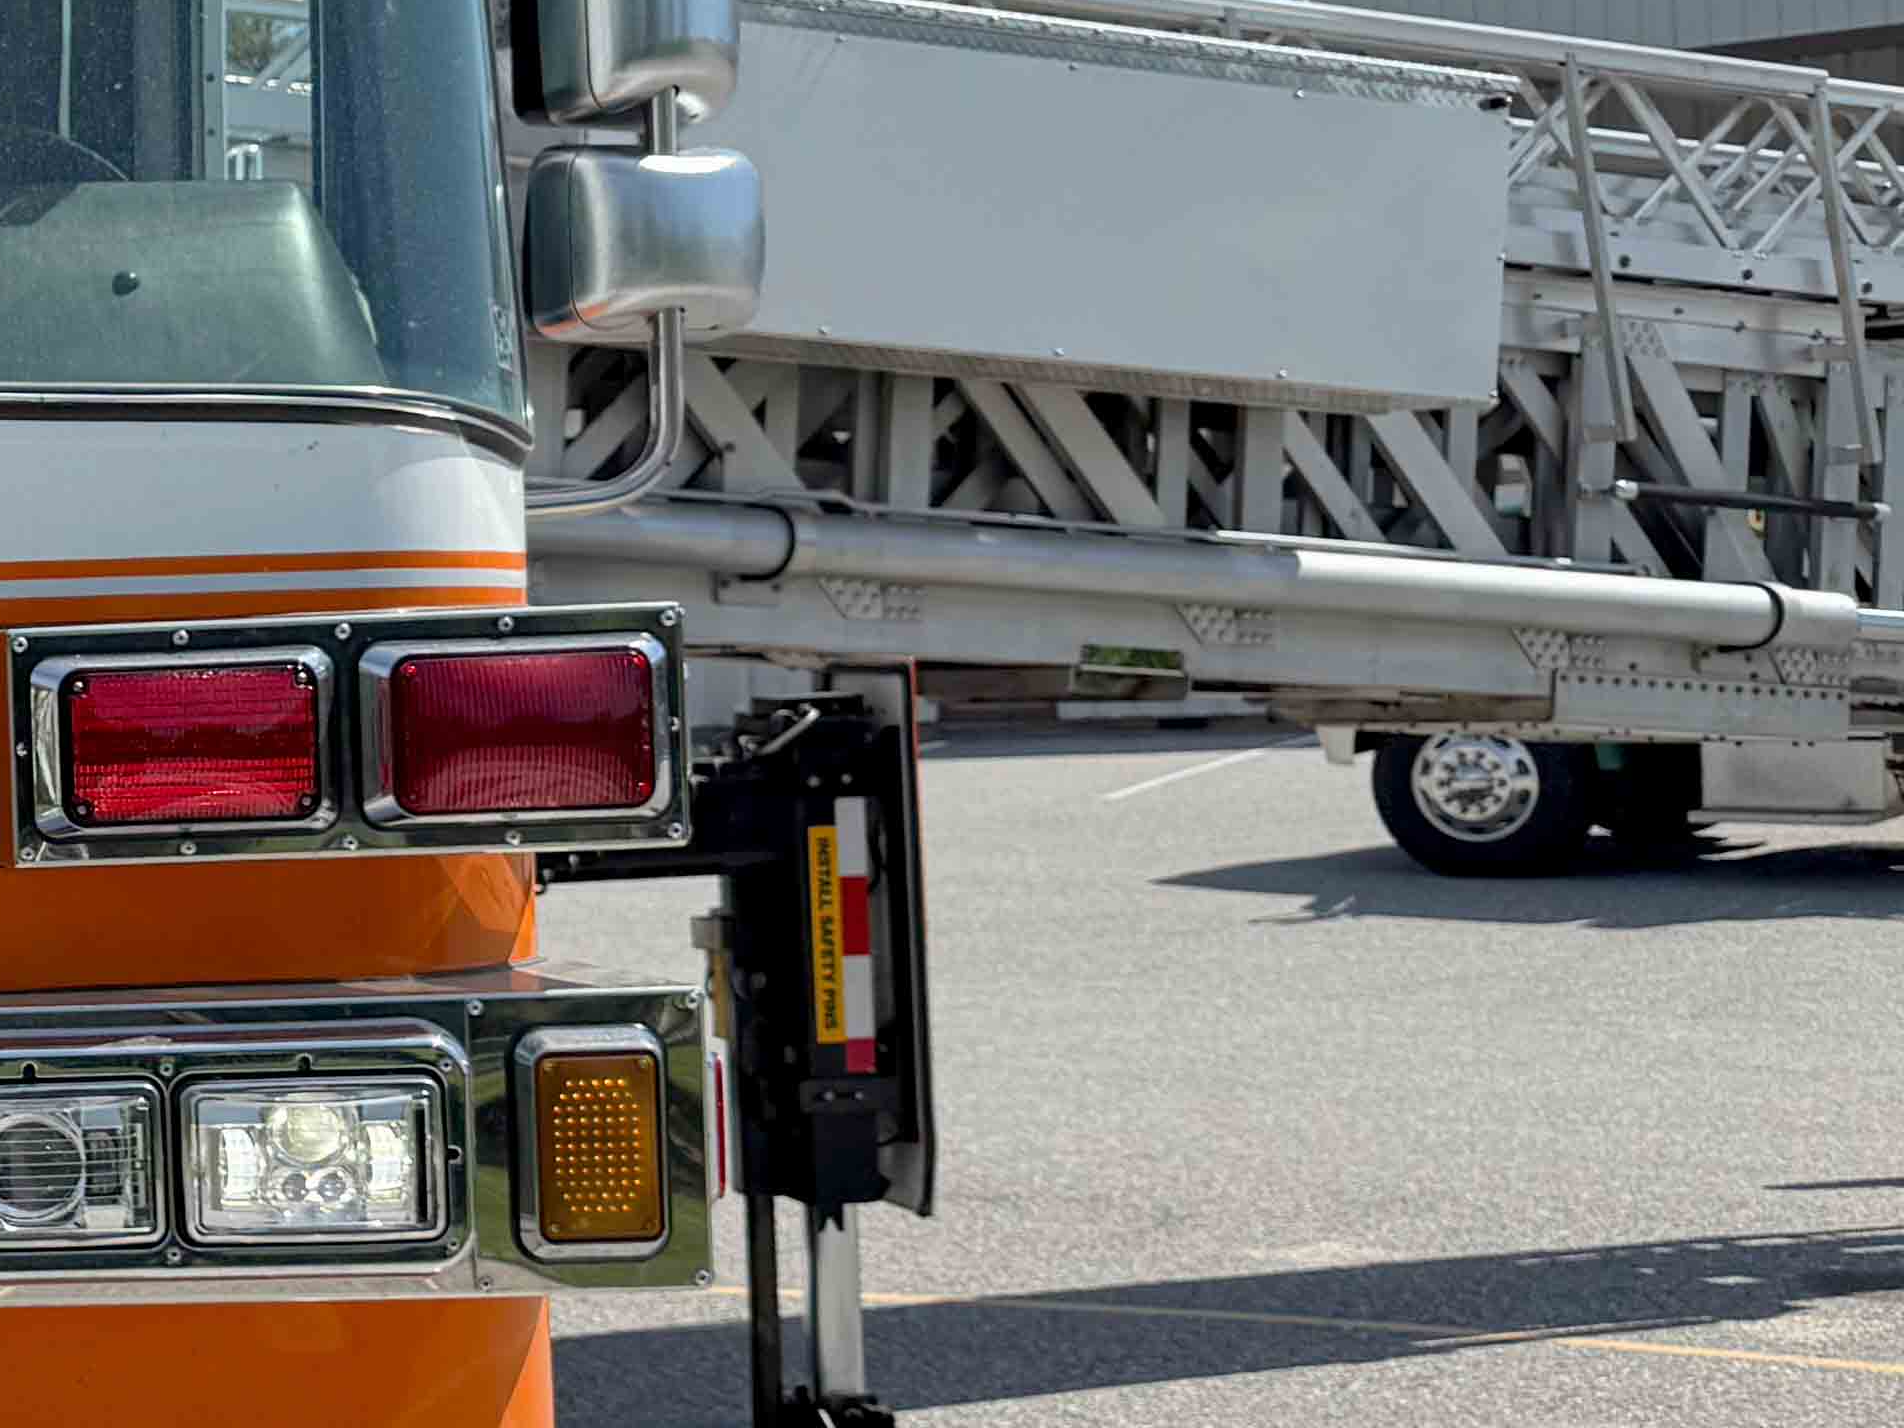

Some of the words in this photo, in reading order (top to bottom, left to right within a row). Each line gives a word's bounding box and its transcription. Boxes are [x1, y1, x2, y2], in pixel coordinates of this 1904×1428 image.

[815, 836, 833, 910] INSTALL
[819, 915, 835, 984] SAFETY
[823, 988, 839, 1031] PINS
